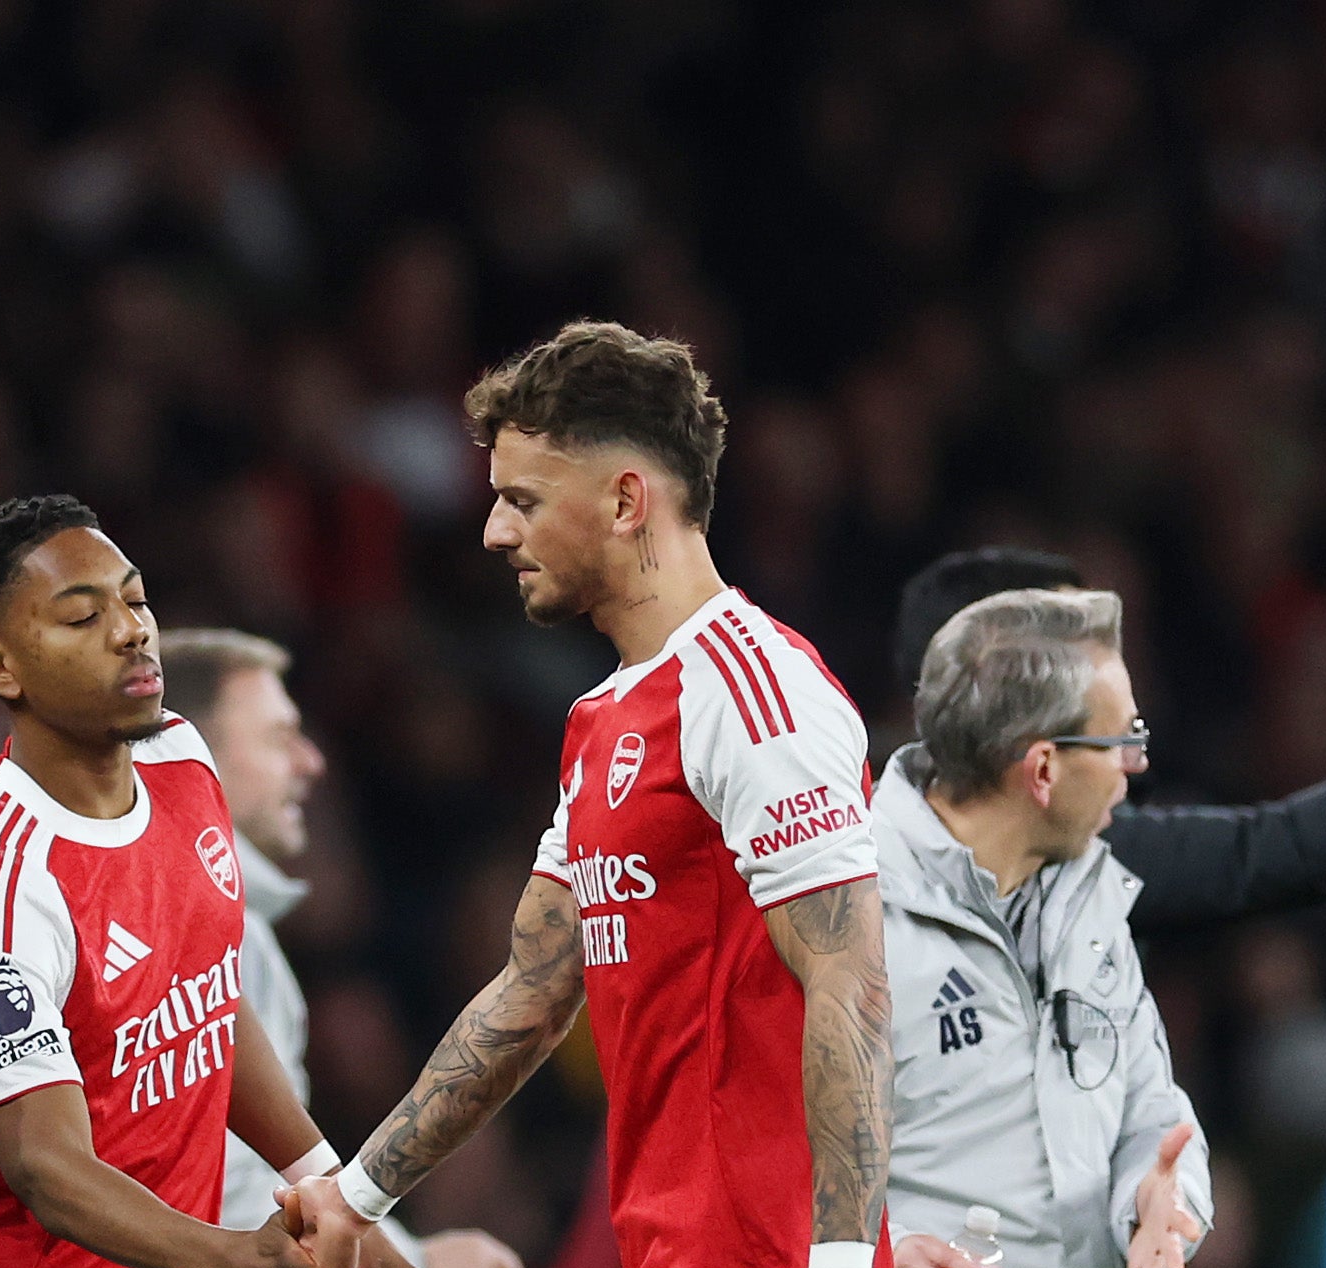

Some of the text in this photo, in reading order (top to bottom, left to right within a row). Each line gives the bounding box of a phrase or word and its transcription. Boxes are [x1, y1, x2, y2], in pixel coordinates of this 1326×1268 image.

[749, 804, 863, 859] RWANDA
[764, 785, 829, 824] VISIT
[111, 943, 242, 1079] Emirat
[940, 1007, 984, 1054] AS
[131, 1012, 236, 1114] FLY BETT
